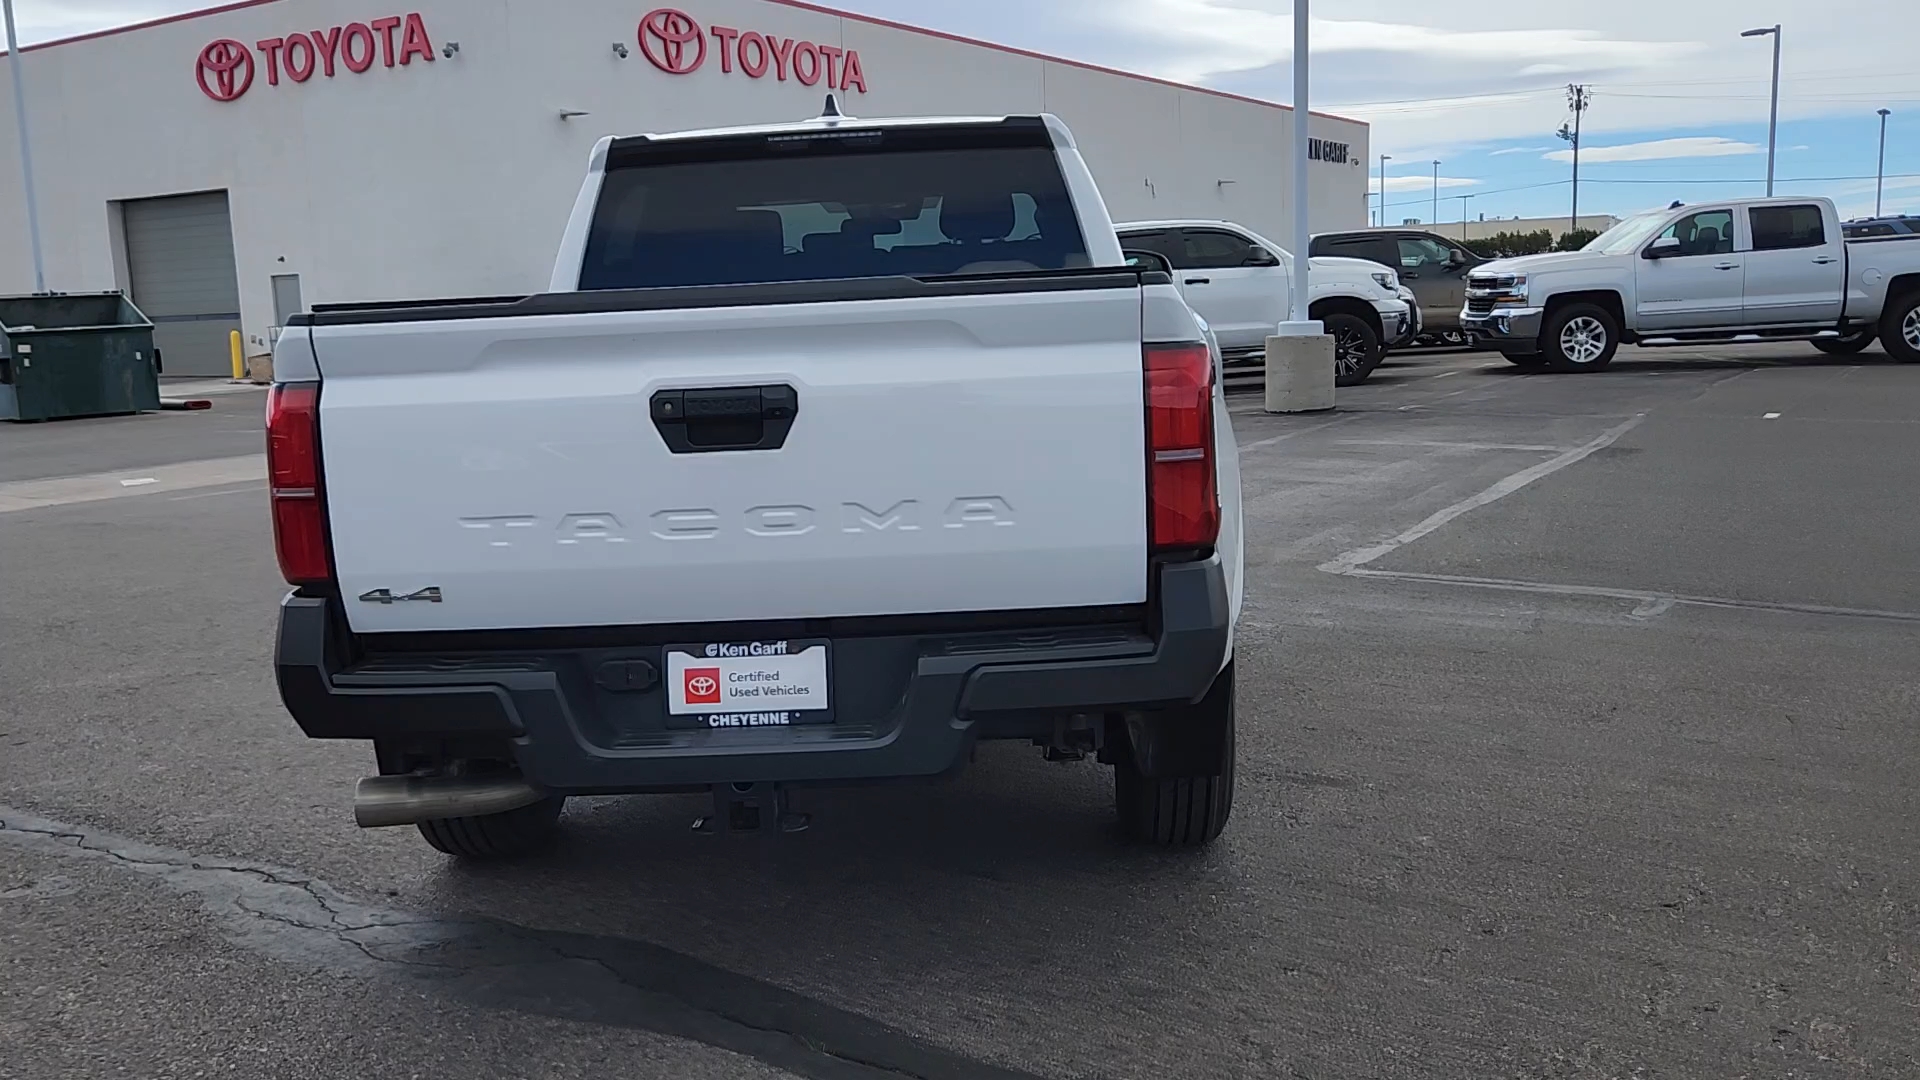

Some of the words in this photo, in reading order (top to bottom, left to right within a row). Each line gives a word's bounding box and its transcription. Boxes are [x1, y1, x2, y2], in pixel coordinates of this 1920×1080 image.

[256, 12, 435, 86] TOYOTA
[711, 25, 867, 94] TOYOTA
[687, 398, 759, 412] TOYOTA
[457, 495, 1015, 547] TACOMA
[719, 643, 750, 657] Ken
[750, 640, 788, 656] Garff
[728, 670, 780, 683] Certified
[729, 686, 759, 698] Used
[762, 684, 810, 697] Vehicles
[709, 712, 790, 727] CHEYENNE
